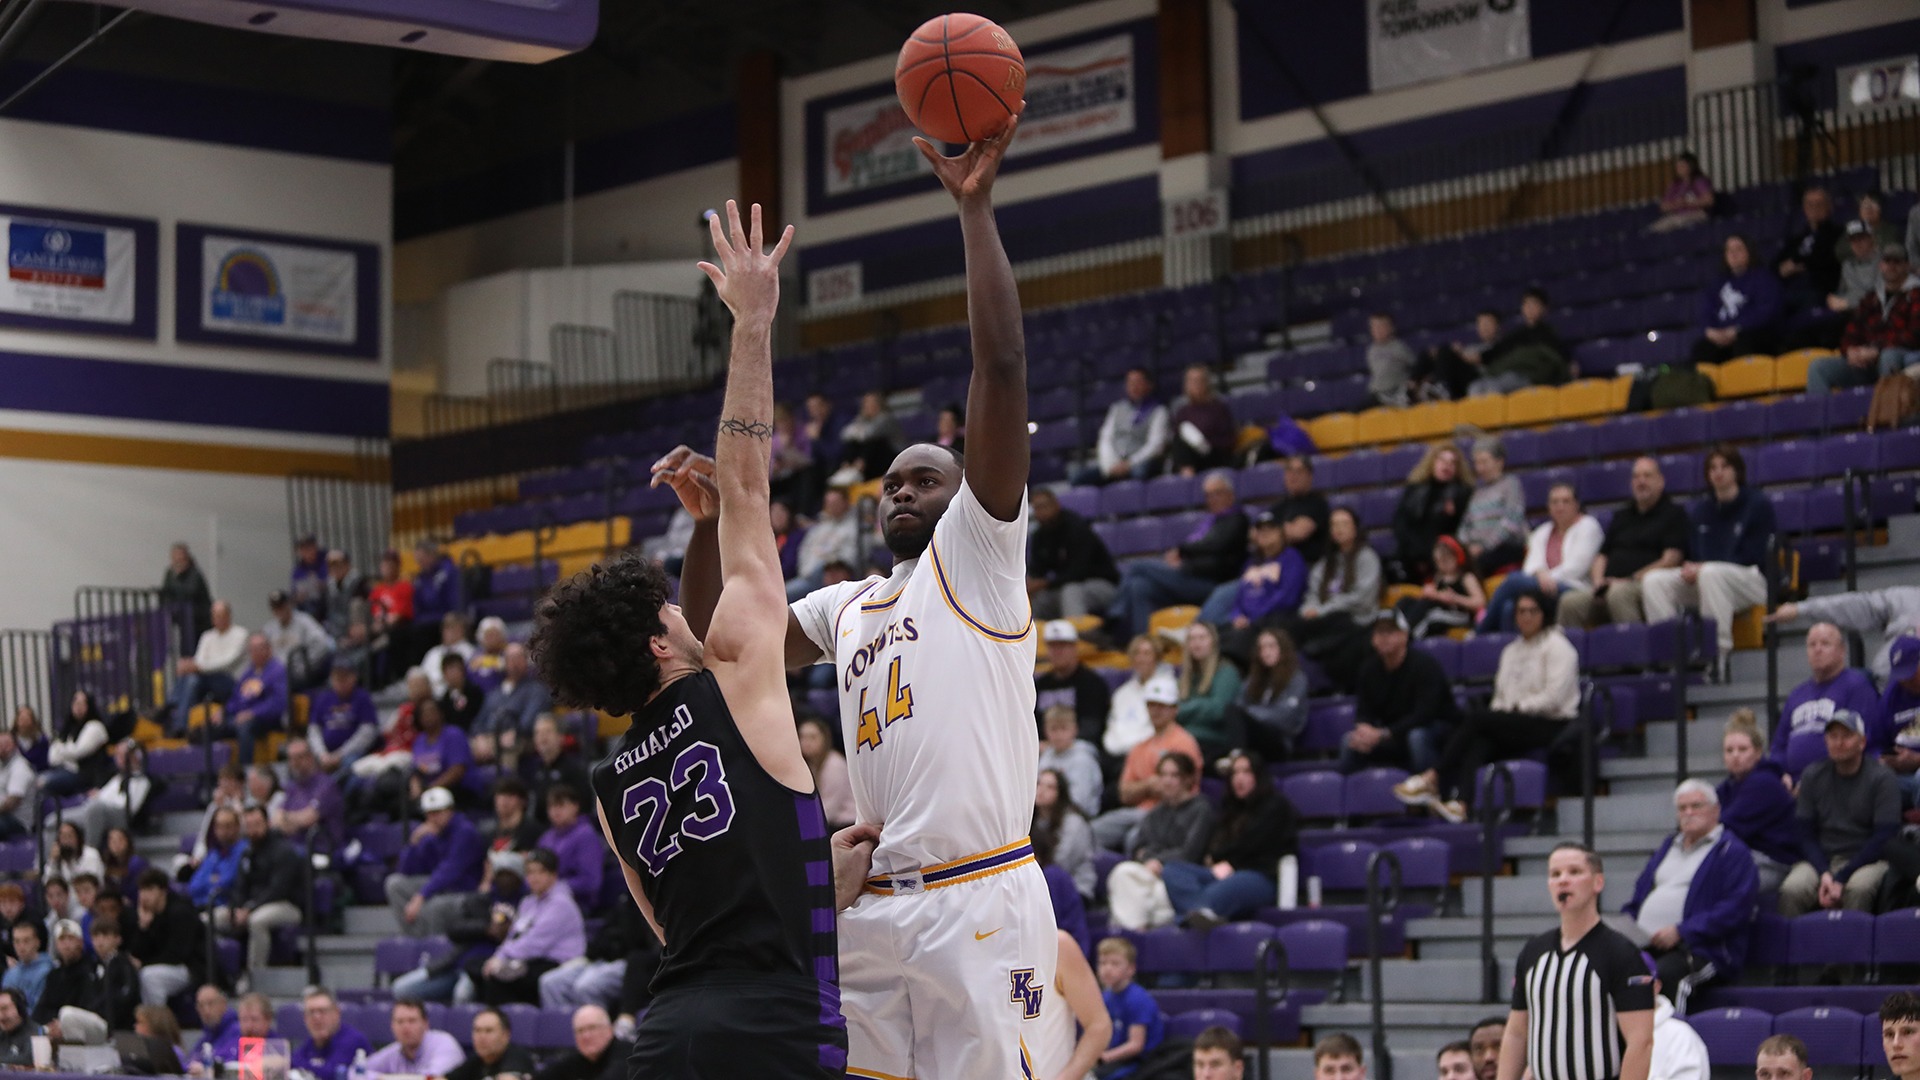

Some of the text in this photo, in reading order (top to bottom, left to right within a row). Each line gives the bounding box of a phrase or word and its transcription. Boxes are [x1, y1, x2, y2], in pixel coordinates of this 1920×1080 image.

[1173, 197, 1218, 236] 106
[844, 616, 919, 693] COYOTES
[614, 703, 694, 775] HIDALGO
[856, 655, 914, 755] 44
[621, 740, 737, 878] 23
[1010, 967, 1044, 1020] KW
